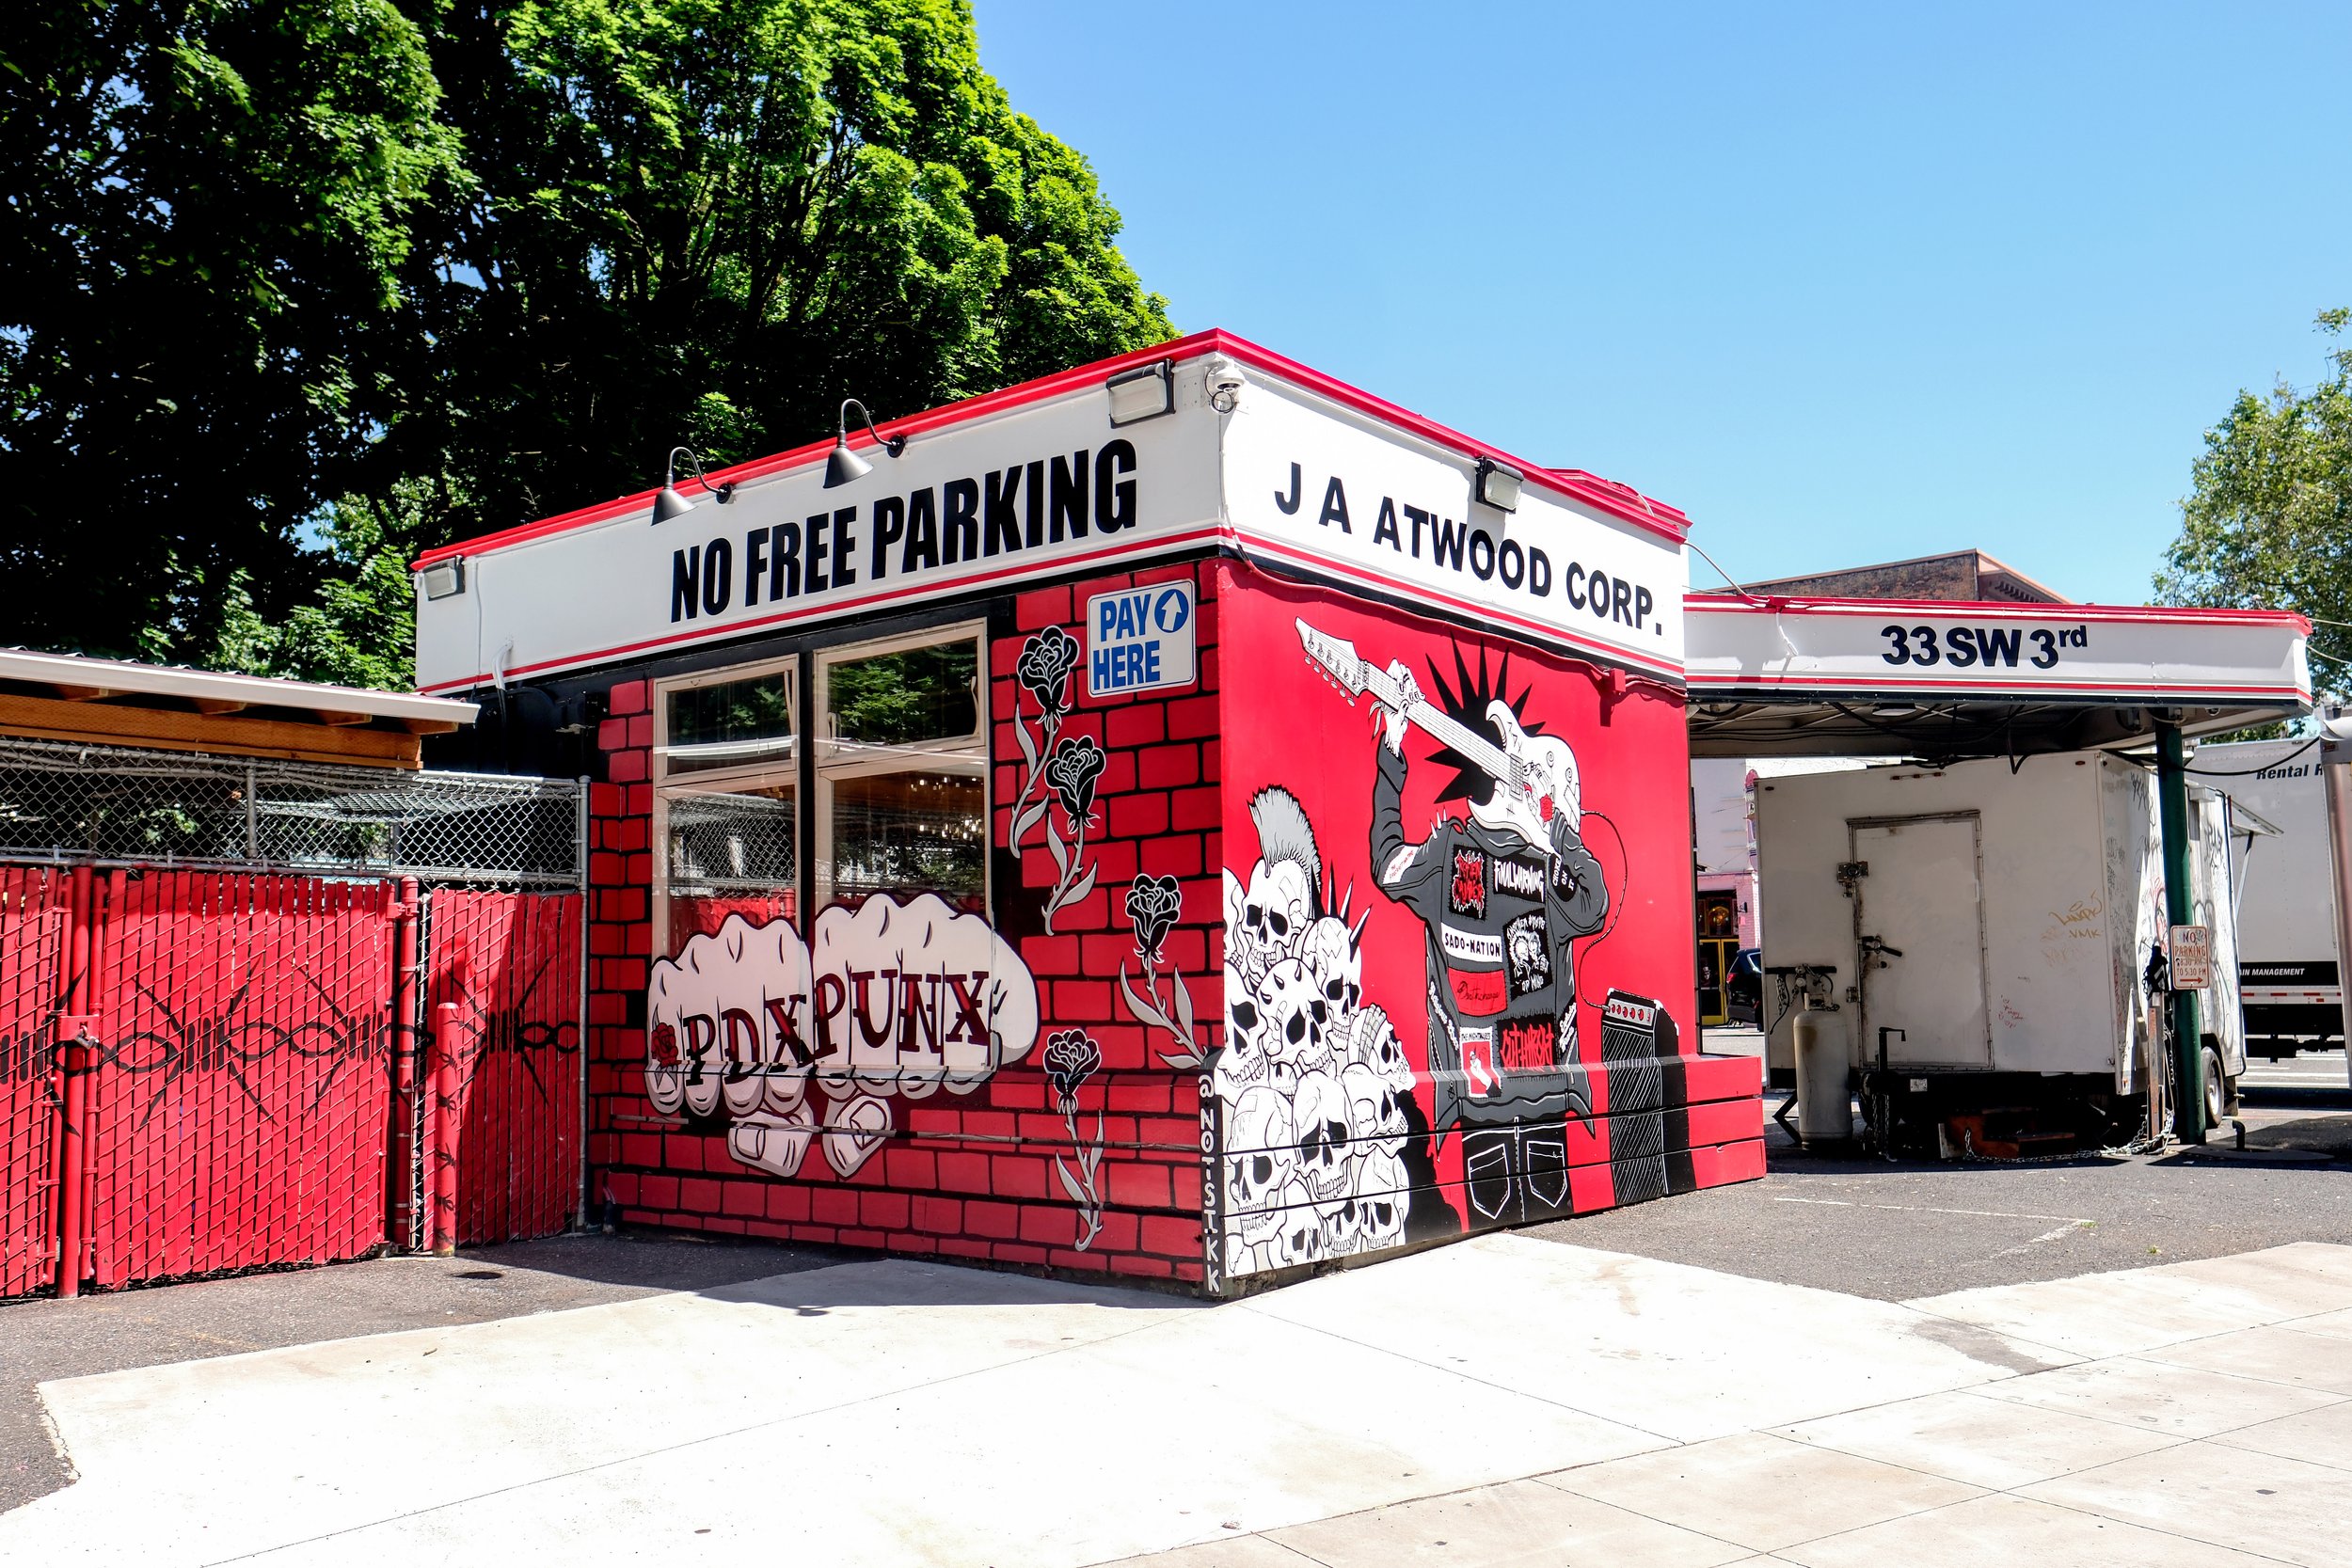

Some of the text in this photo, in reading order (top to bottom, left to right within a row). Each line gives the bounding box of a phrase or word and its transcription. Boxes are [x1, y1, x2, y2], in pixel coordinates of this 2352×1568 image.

[670, 438, 1137, 623] NO FREE PARKING
[1274, 461, 1662, 636] J A ATWOOD CORP.
[1100, 593, 1152, 642] PAY
[1881, 625, 2088, 669] 33 SW 3rd
[1092, 640, 1161, 690] HERE
[2256, 764, 2310, 780] Rental
[1552, 857, 1562, 887] CHOKE
[1562, 870, 1568, 885] ON
[1444, 932, 1502, 958] SADO-NATION
[2175, 944, 2206, 957] PARKING
[2183, 930, 2196, 943] NO
[2251, 968, 2305, 976] MANAGEMENT
[682, 970, 991, 1086] PDX PUNX
